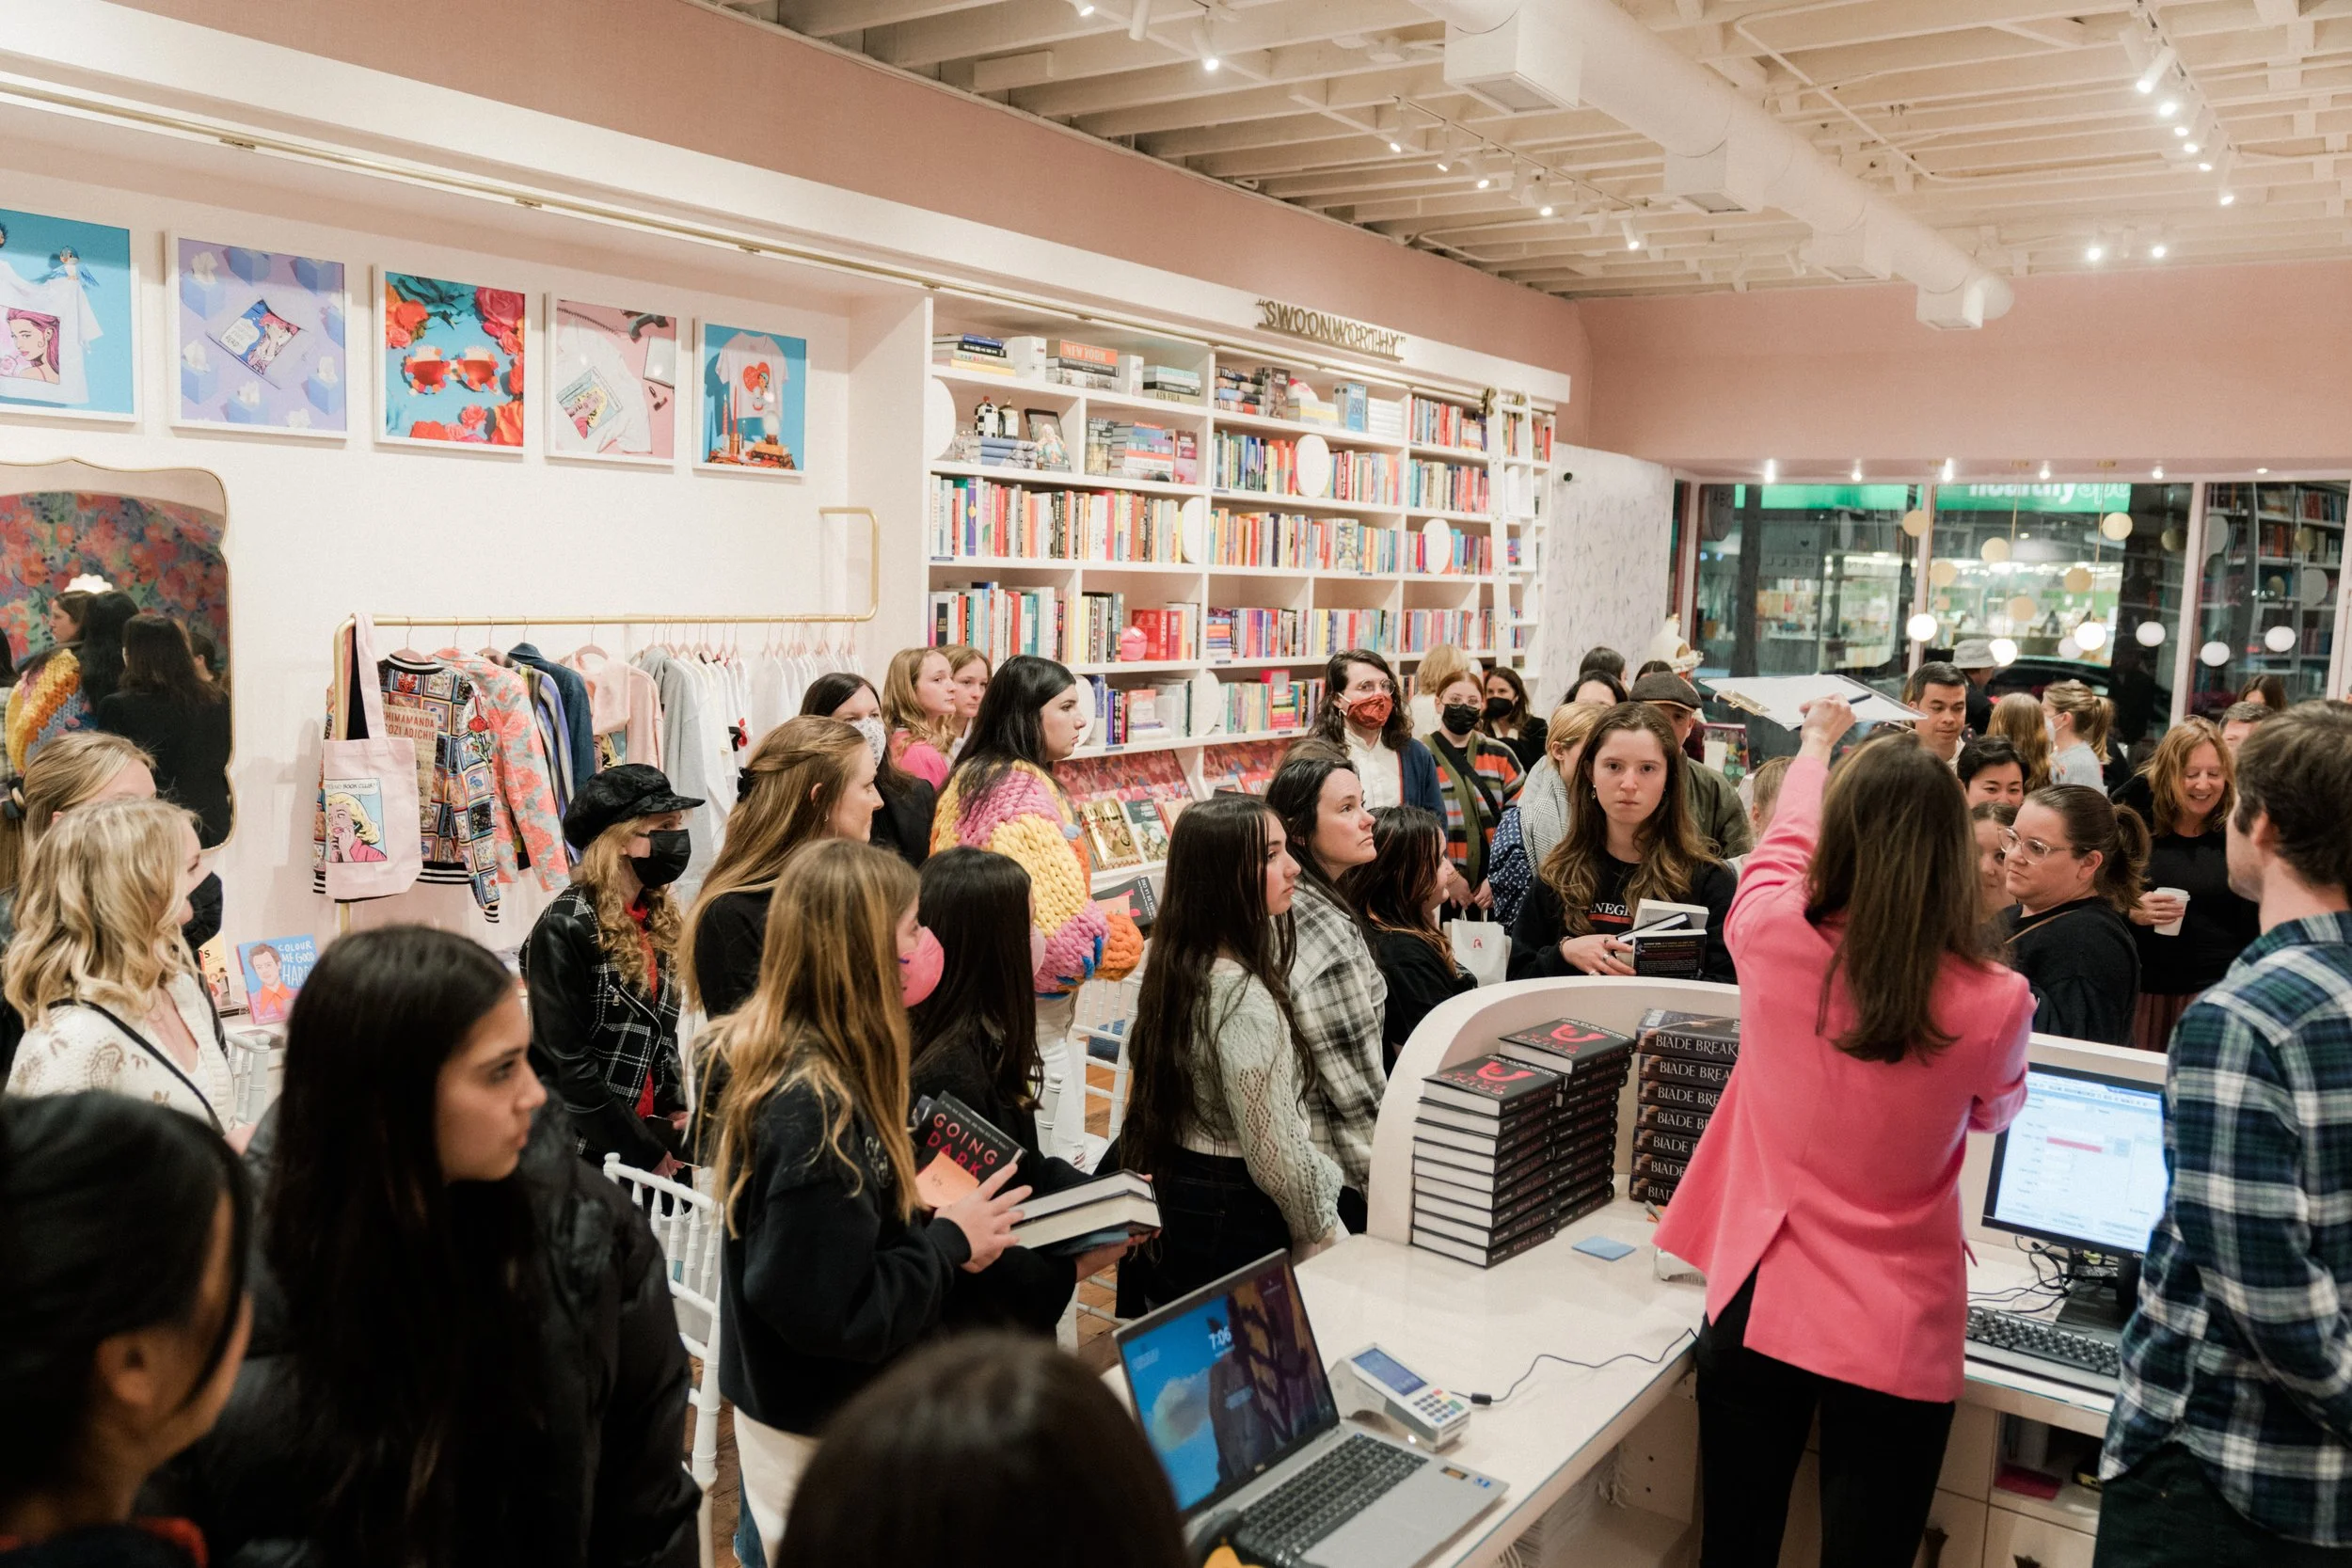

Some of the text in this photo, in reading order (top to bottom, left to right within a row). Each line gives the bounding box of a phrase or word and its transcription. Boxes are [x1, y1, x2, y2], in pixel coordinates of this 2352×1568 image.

[384, 711, 435, 728] HIMAMANDA
[404, 727, 436, 741] ADICHIE
[278, 941, 312, 952] COLOUR
[281, 952, 315, 964] ME GOOD
[1656, 1035, 1740, 1057] BLADE BREAK
[1660, 1061, 1731, 1082] BLADE BREA
[1658, 1086, 1721, 1108] BLADE BRE
[1657, 1112, 1693, 1128] BLADE
[933, 1113, 998, 1165] GOING
[1653, 1135, 1688, 1153] BLADE
[928, 1131, 983, 1178] DARK
[1651, 1161, 1685, 1177] BLADE
[1647, 1186, 1675, 1200] BLAD
[1208, 1326, 1232, 1351] 7:06
